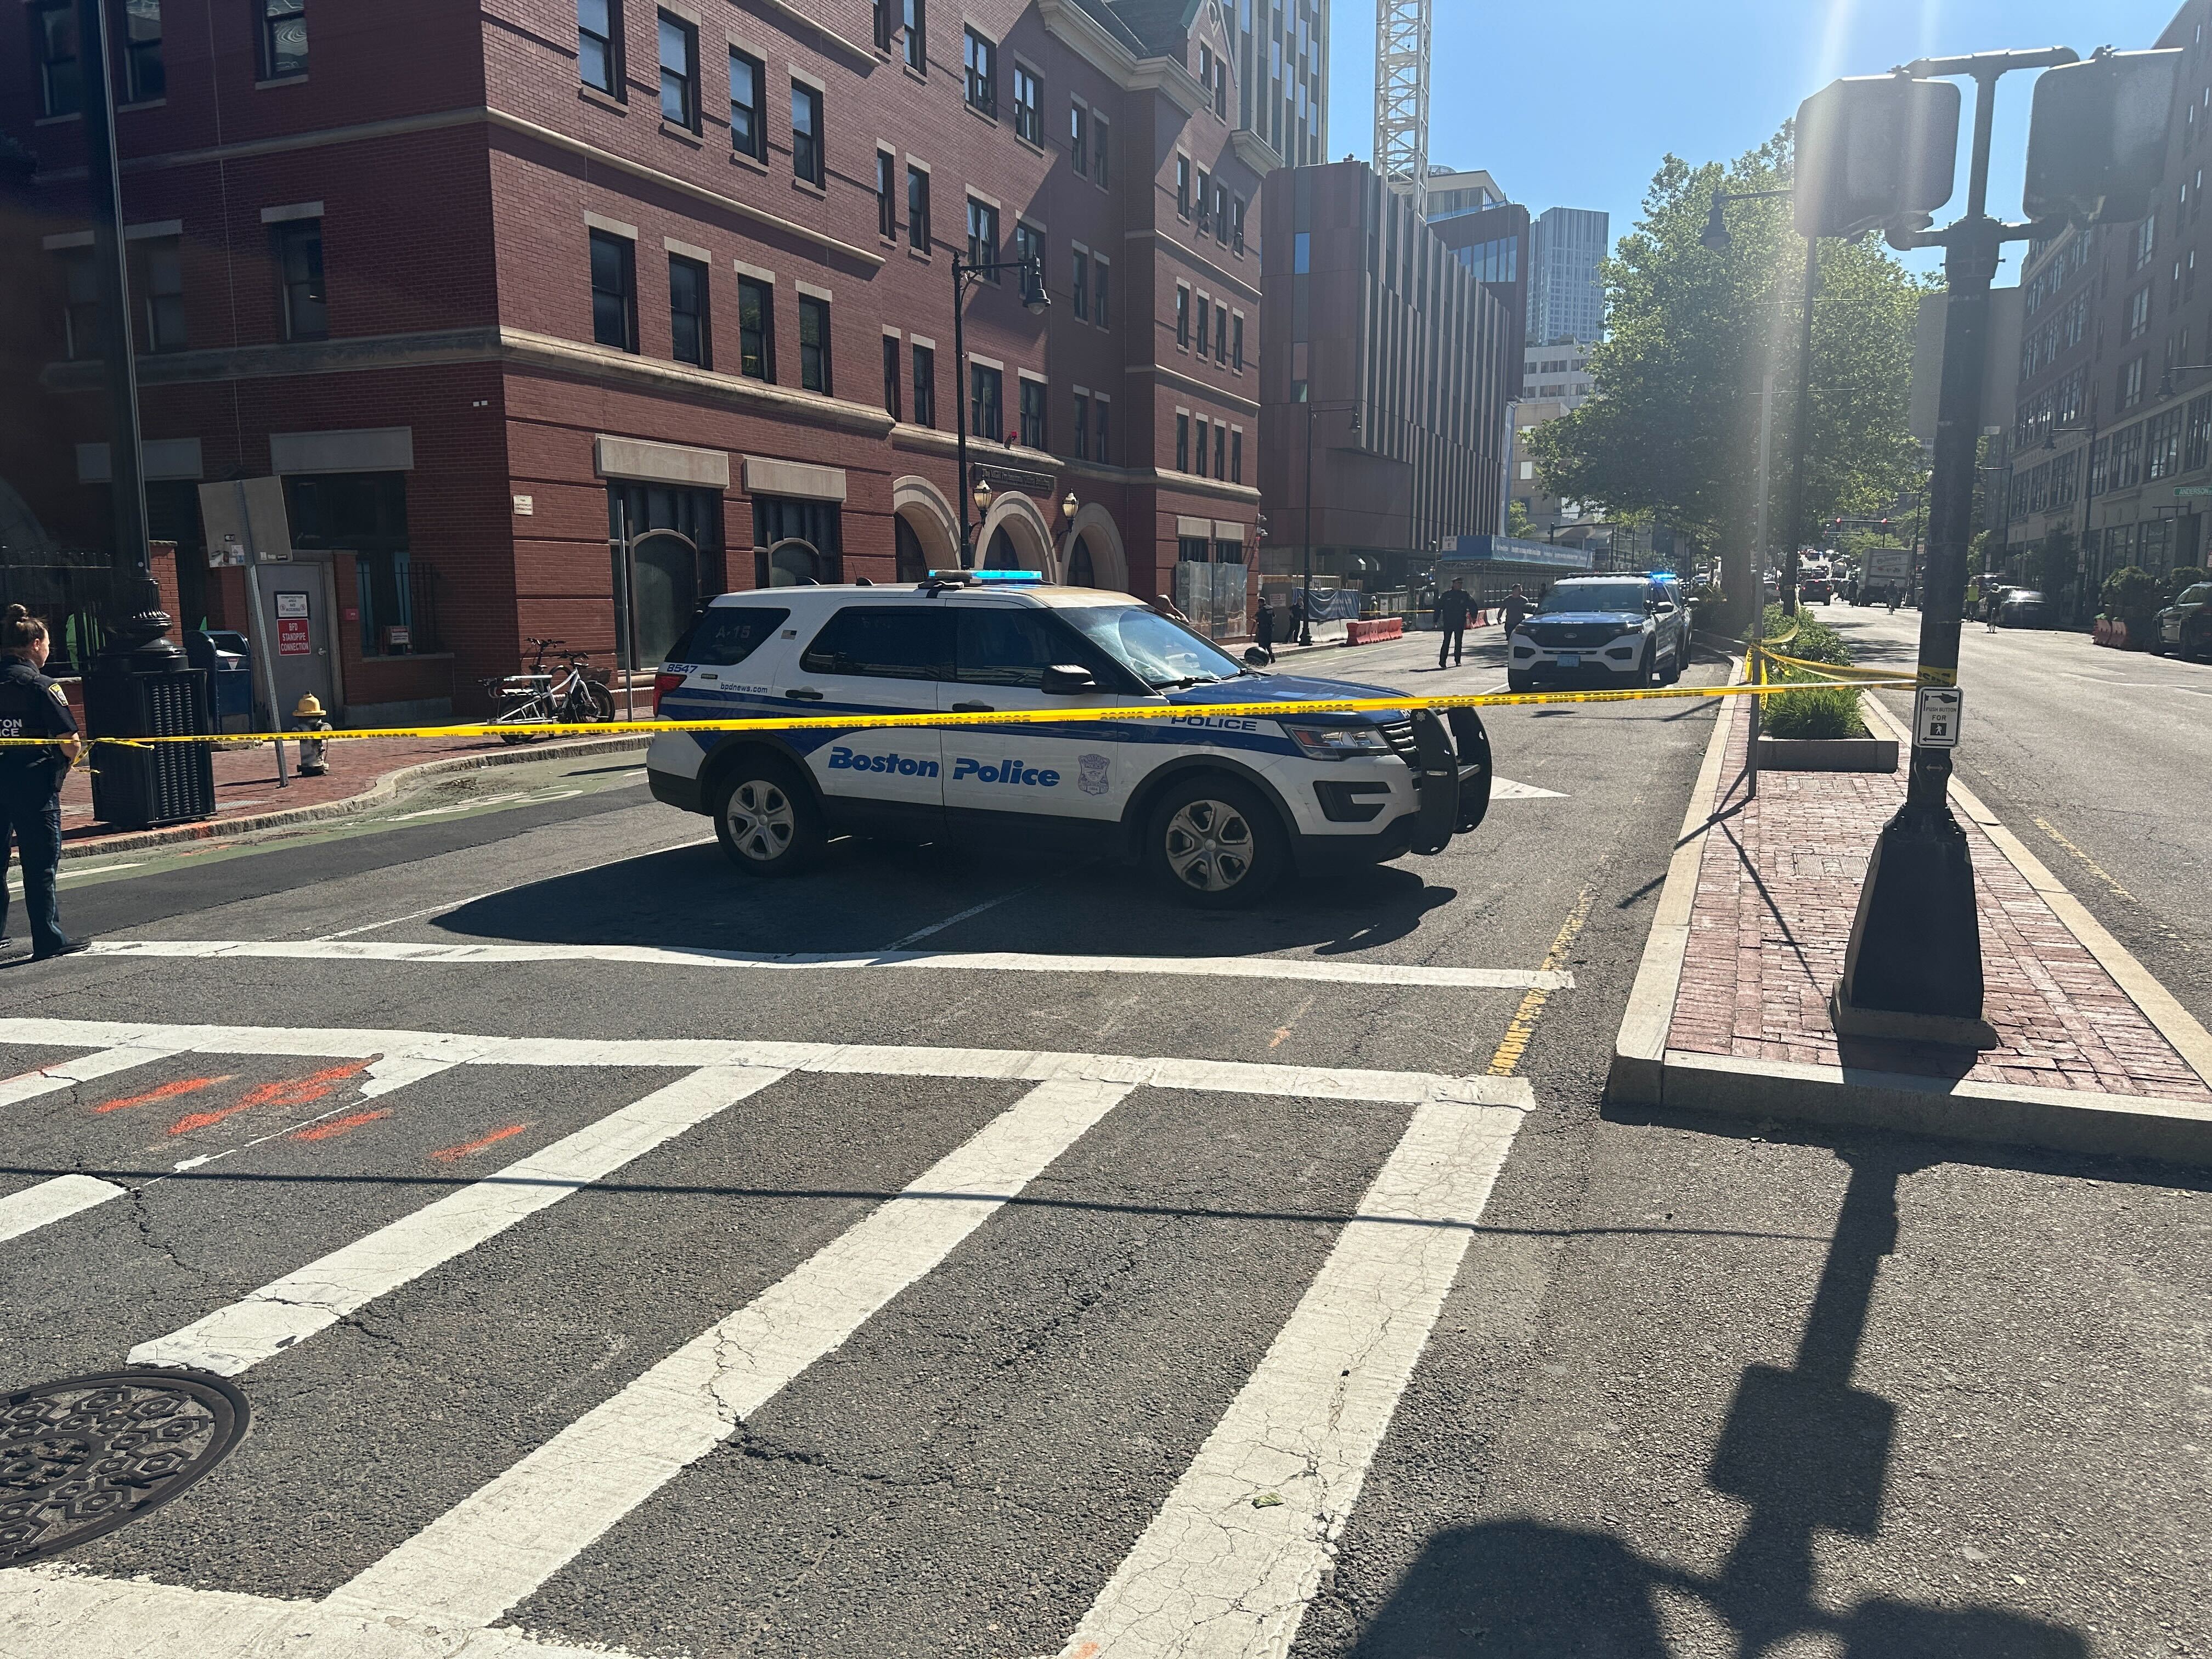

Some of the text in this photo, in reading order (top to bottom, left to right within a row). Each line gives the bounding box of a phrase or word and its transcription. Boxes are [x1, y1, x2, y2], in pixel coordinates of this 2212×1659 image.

[289, 623, 298, 631] BFD
[282, 632, 306, 641] STANDPIPE
[280, 642, 309, 652] CONNECTION
[667, 663, 698, 674] 8547
[720, 682, 768, 693] bpdnews.com
[1171, 716, 1257, 731] POLICE
[828, 746, 1060, 787] Boston Police
